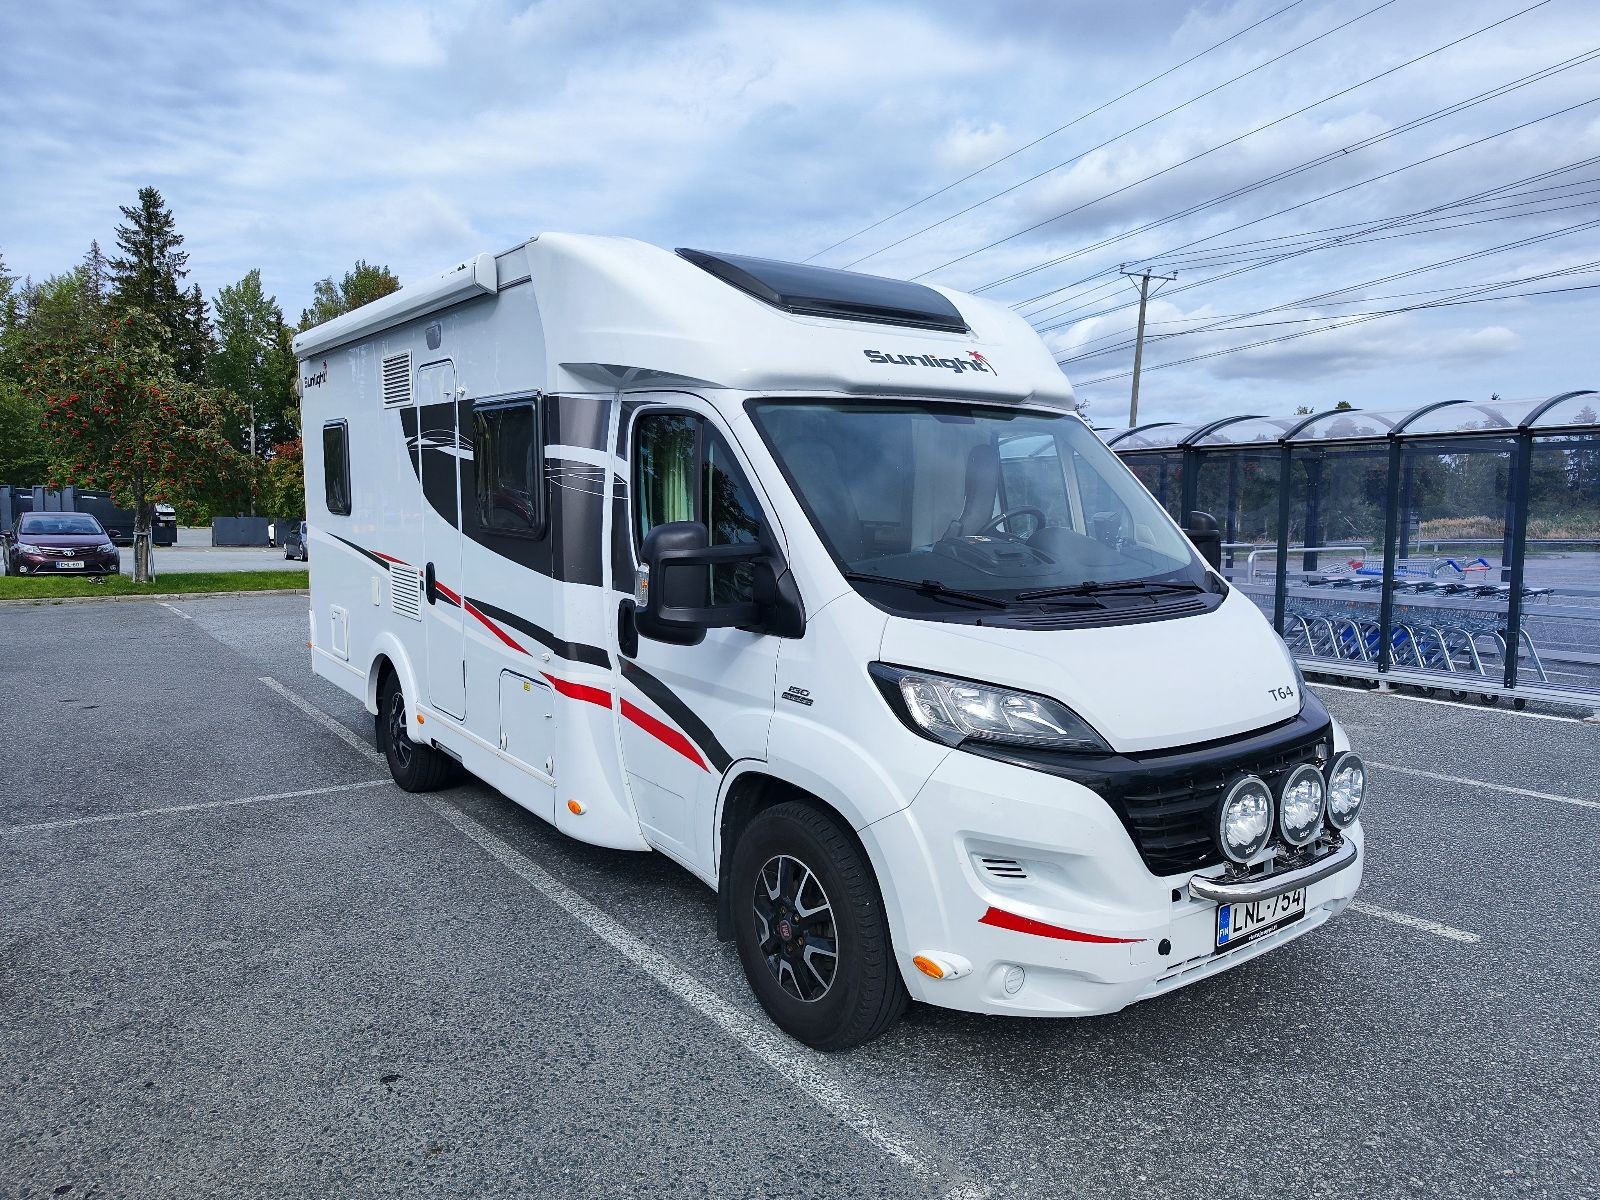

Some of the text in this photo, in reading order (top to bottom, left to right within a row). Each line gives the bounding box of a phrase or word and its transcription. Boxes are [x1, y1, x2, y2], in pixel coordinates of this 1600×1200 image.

[863, 349, 989, 374] Sunlight
[1267, 685, 1294, 701] T64
[1219, 927, 1229, 938] FIN
